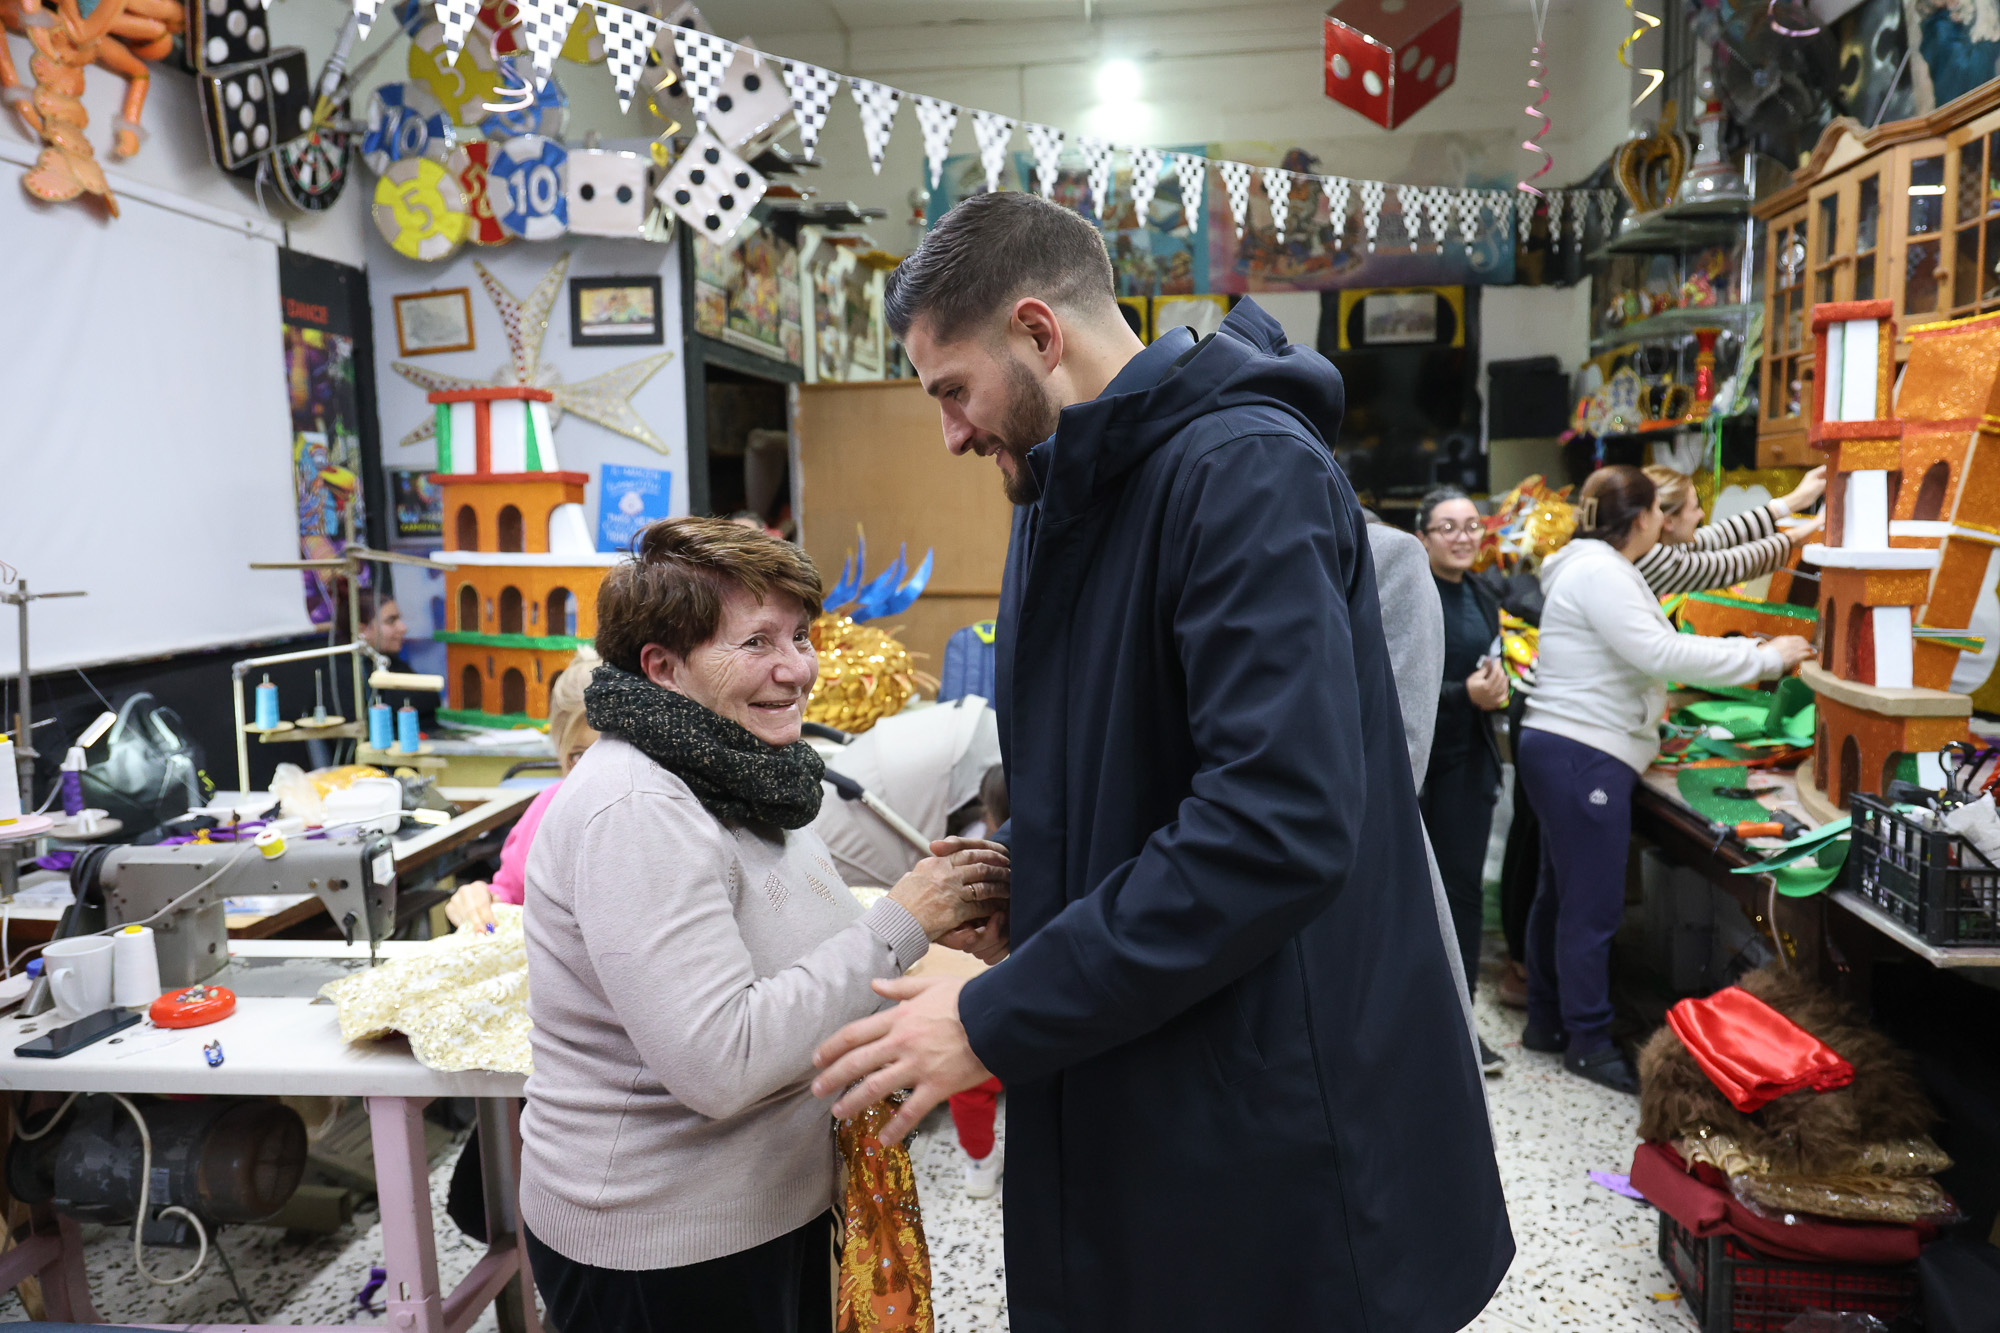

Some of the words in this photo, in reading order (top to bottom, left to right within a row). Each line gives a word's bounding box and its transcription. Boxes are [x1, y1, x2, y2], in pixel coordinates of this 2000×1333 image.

[434, 51, 466, 97] 5
[385, 107, 429, 157] 10
[400, 187, 434, 232] 5
[510, 164, 558, 216] 10
